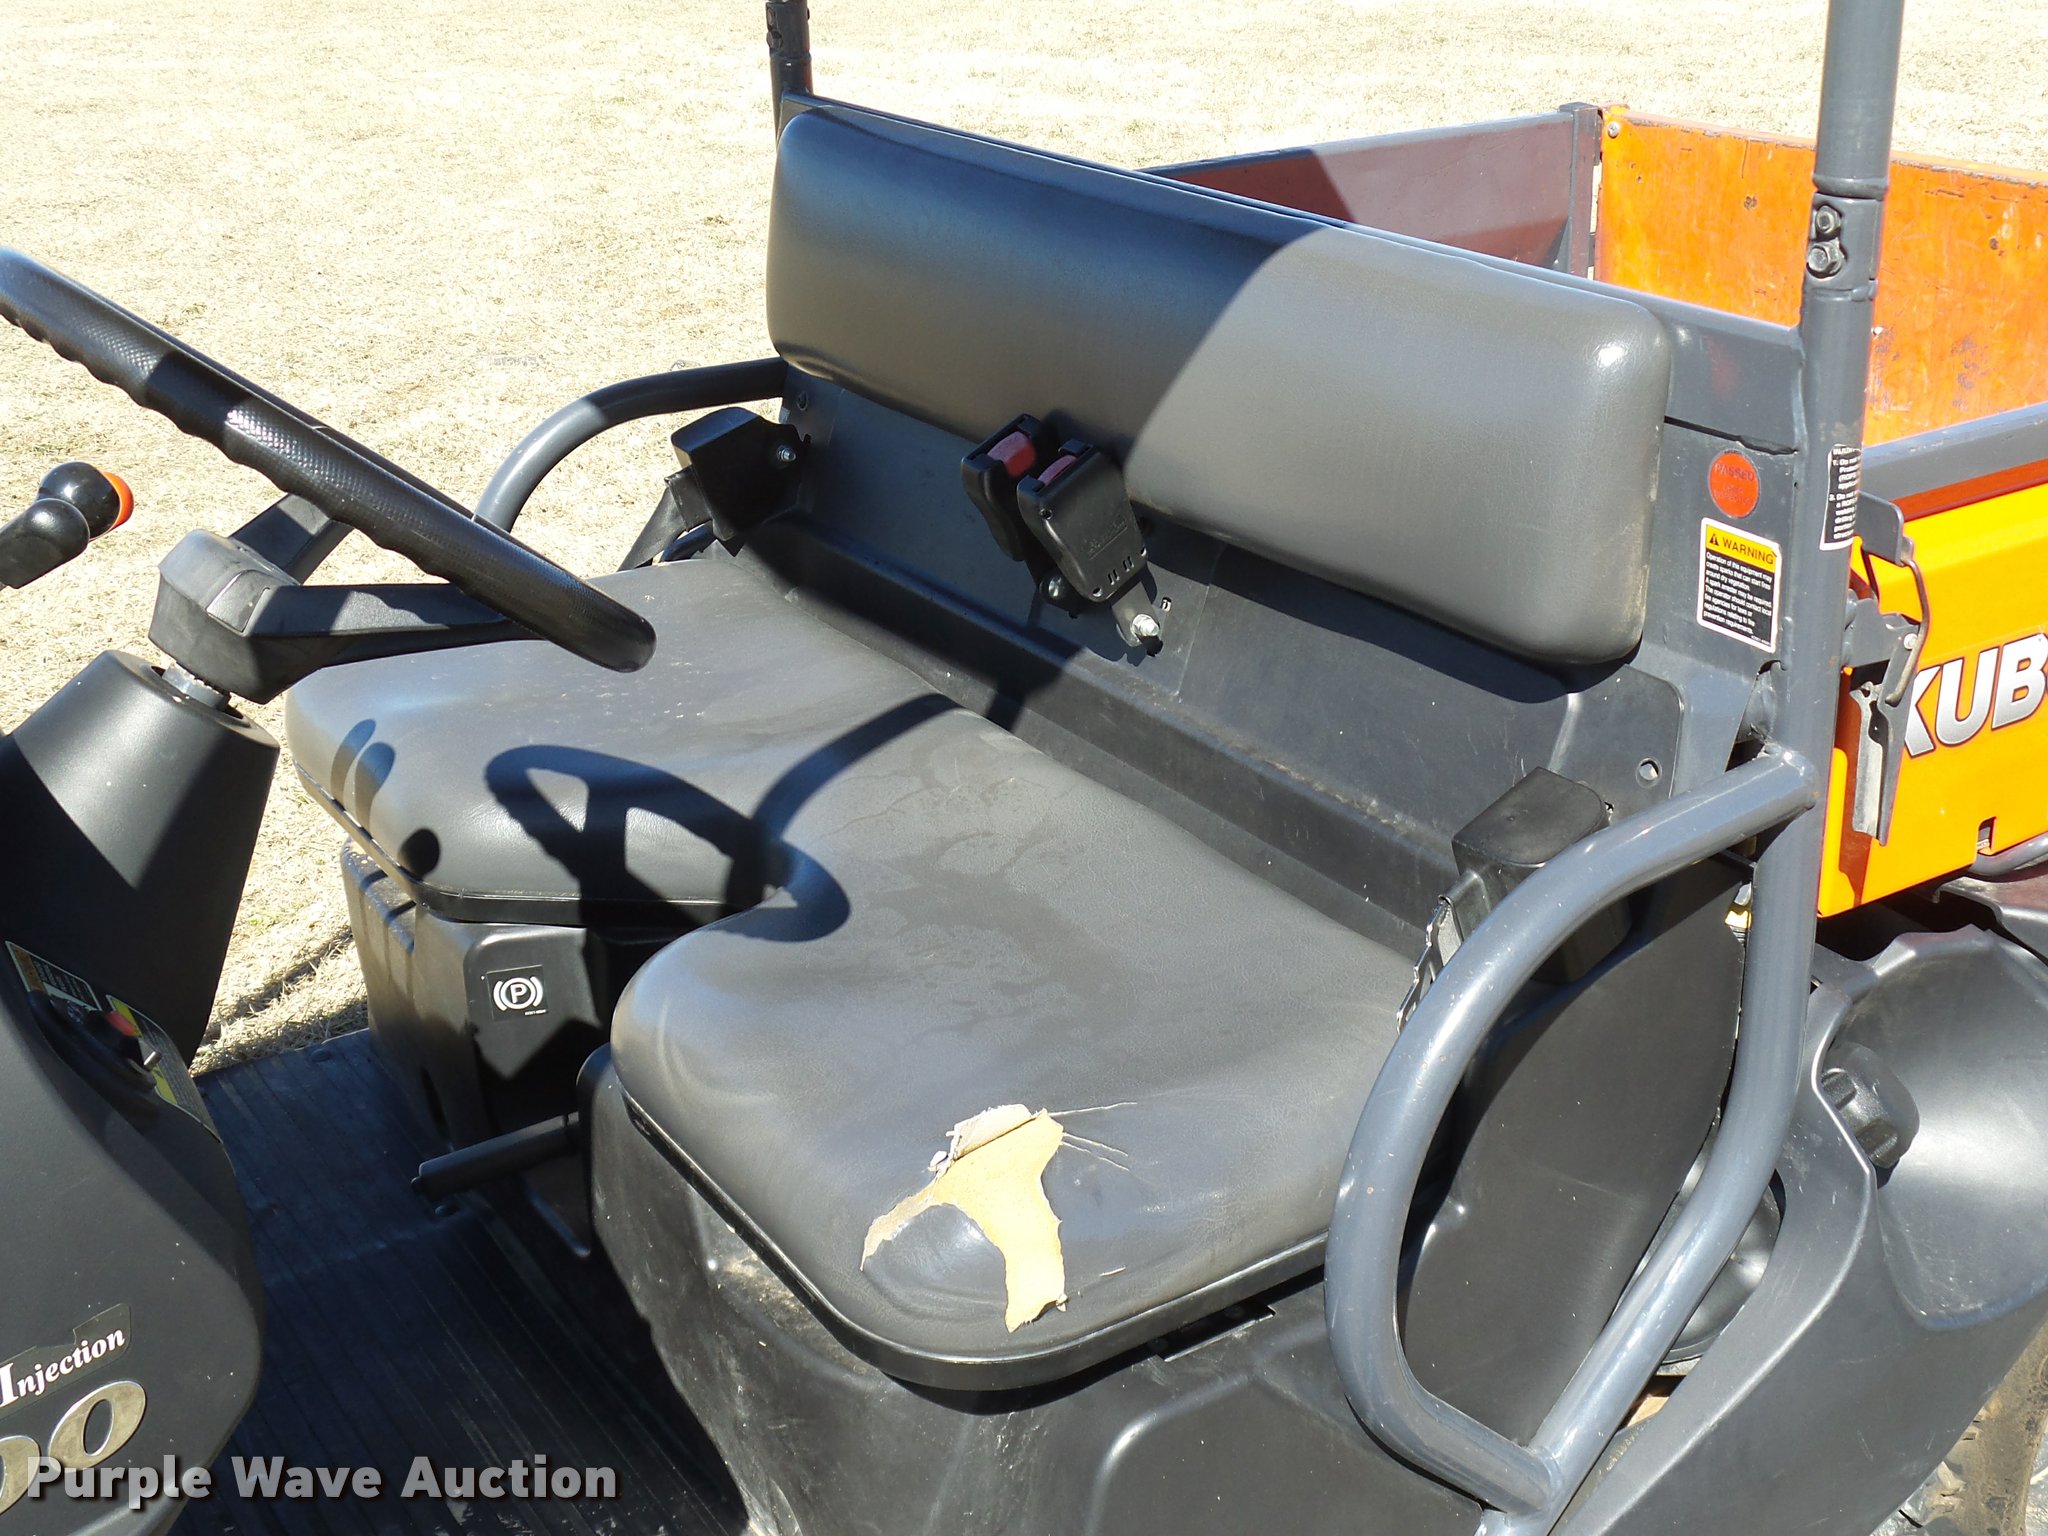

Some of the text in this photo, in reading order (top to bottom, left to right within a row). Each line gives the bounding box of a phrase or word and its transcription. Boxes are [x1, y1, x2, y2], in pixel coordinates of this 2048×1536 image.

[1714, 462, 1755, 482] PASSED
[1722, 536, 1774, 565] WARNING
[1763, 574, 1772, 583] may
[1705, 585, 1713, 593] The
